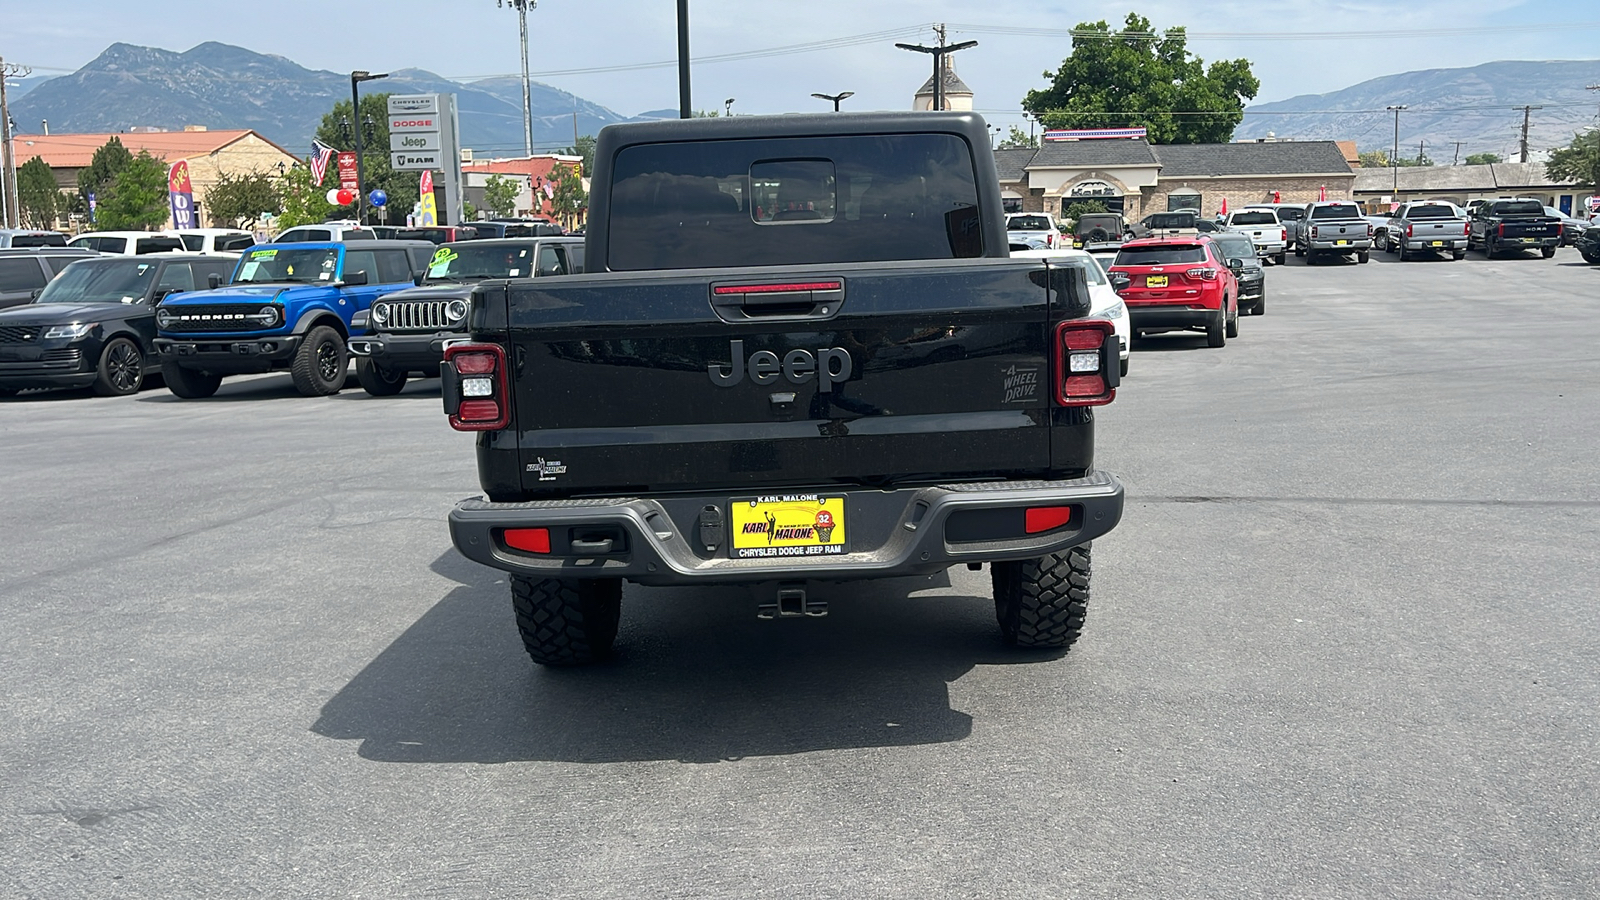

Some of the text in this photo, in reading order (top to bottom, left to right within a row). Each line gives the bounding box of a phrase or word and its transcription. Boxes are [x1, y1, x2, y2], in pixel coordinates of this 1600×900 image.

[401, 136, 427, 148] Jeep
[173, 163, 188, 191] PRE
[437, 249, 448, 258] 25
[180, 313, 245, 321] BRONCO
[708, 339, 853, 393] Jeep
[1006, 364, 1016, 376] 4
[1004, 372, 1037, 390] WHEEL
[1005, 385, 1036, 403] DRIVE
[783, 494, 818, 502] MALONE
[818, 514, 830, 524] 32
[742, 522, 768, 534] KARL
[774, 527, 814, 540] MALONE
[739, 544, 842, 557] CHRYSLER DODGE JEEP RAM
